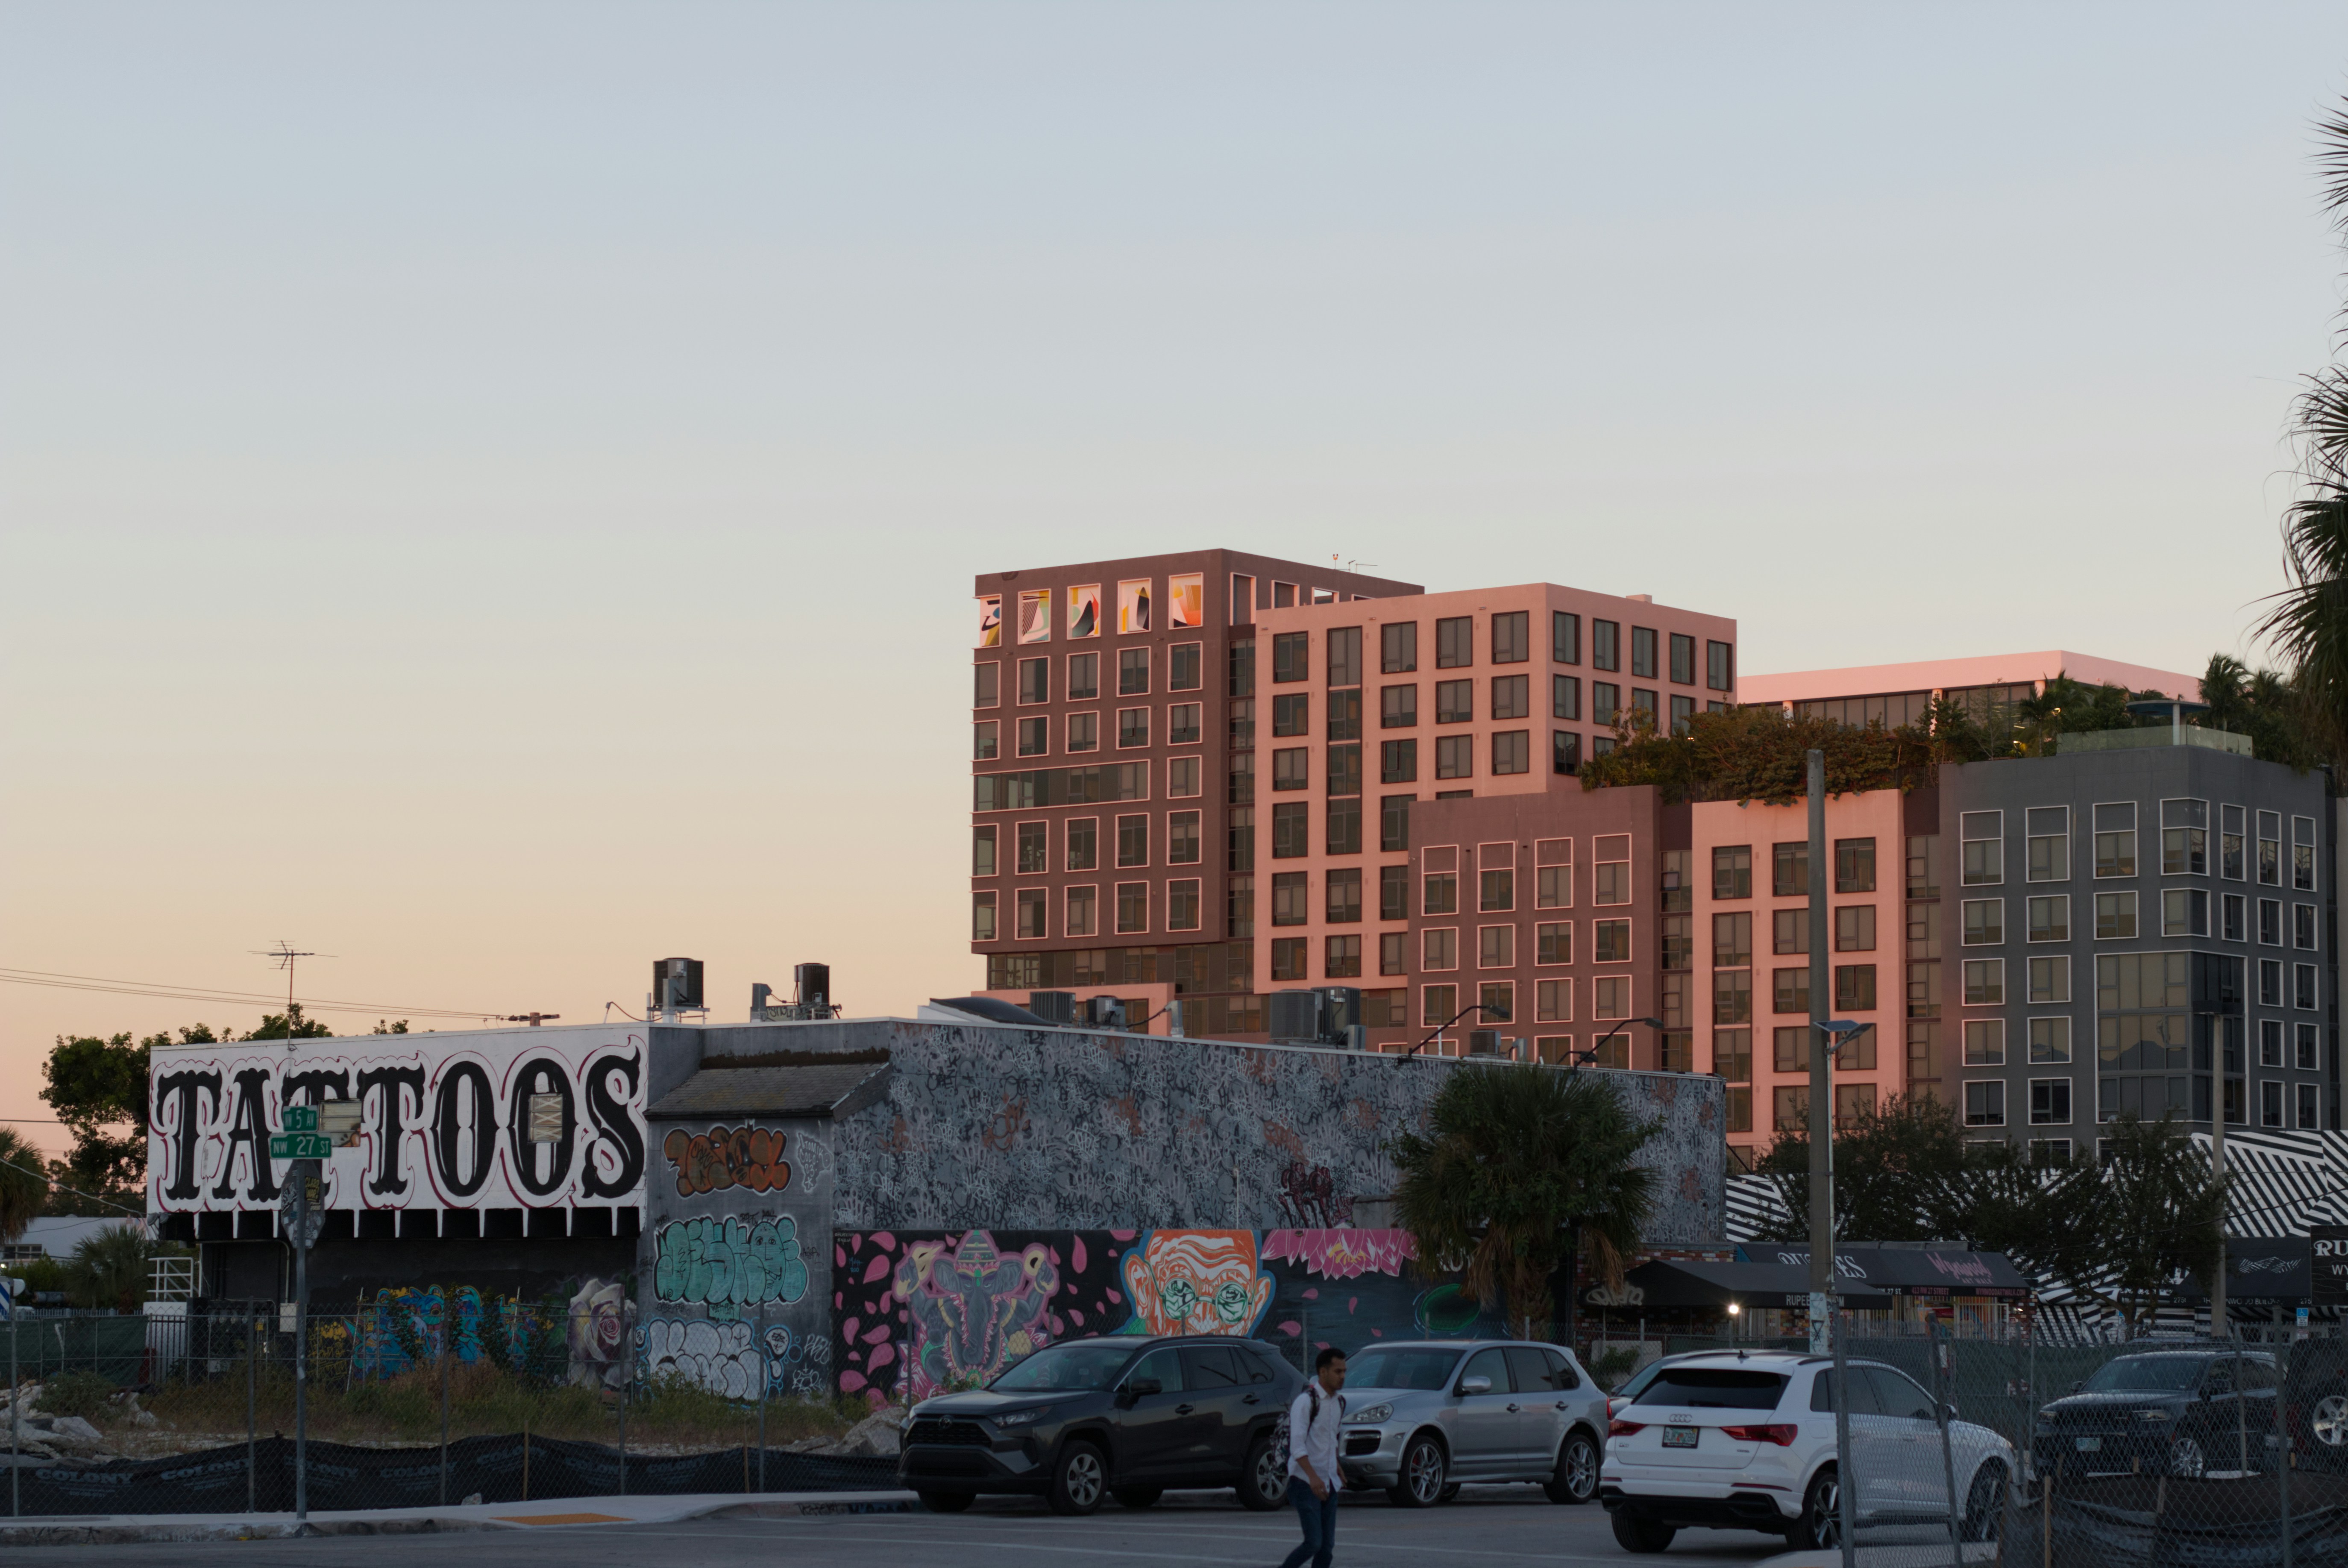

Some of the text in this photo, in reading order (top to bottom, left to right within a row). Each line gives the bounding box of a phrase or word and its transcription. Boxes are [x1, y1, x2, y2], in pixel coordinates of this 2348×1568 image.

[285, 1110, 314, 1129] NW 5 AV
[273, 1136, 329, 1155] NW 27 ST
[36, 1468, 134, 1484] COLONY
